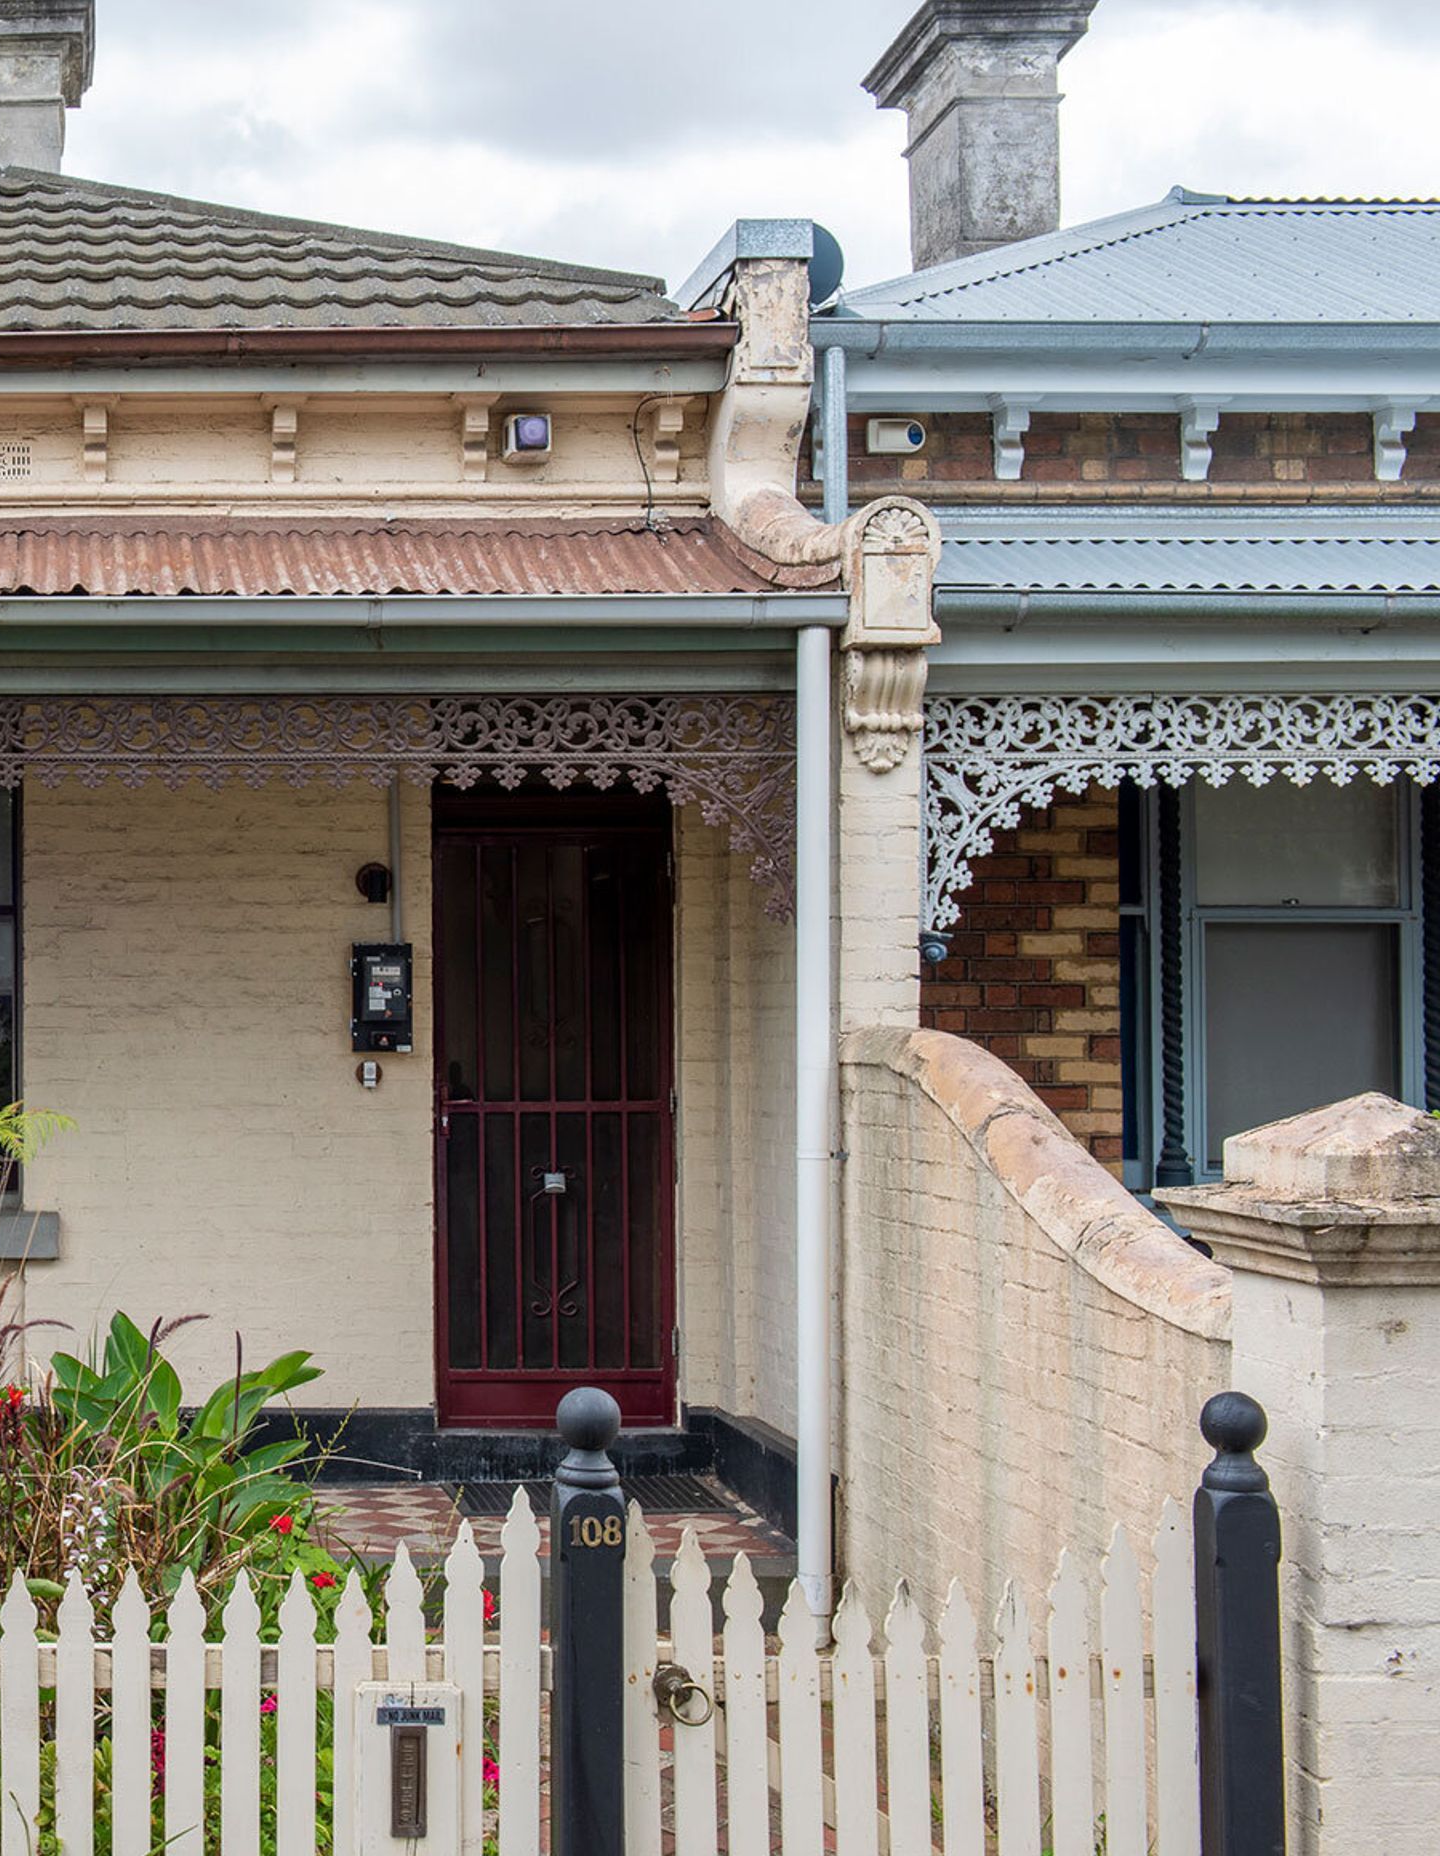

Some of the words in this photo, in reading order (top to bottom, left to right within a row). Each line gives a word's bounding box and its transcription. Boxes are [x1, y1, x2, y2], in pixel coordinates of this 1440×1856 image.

[568, 1515, 623, 1548] 108
[388, 1711, 399, 1721] NO
[401, 1711, 420, 1721] JUNK
[423, 1711, 442, 1721] MAIL
